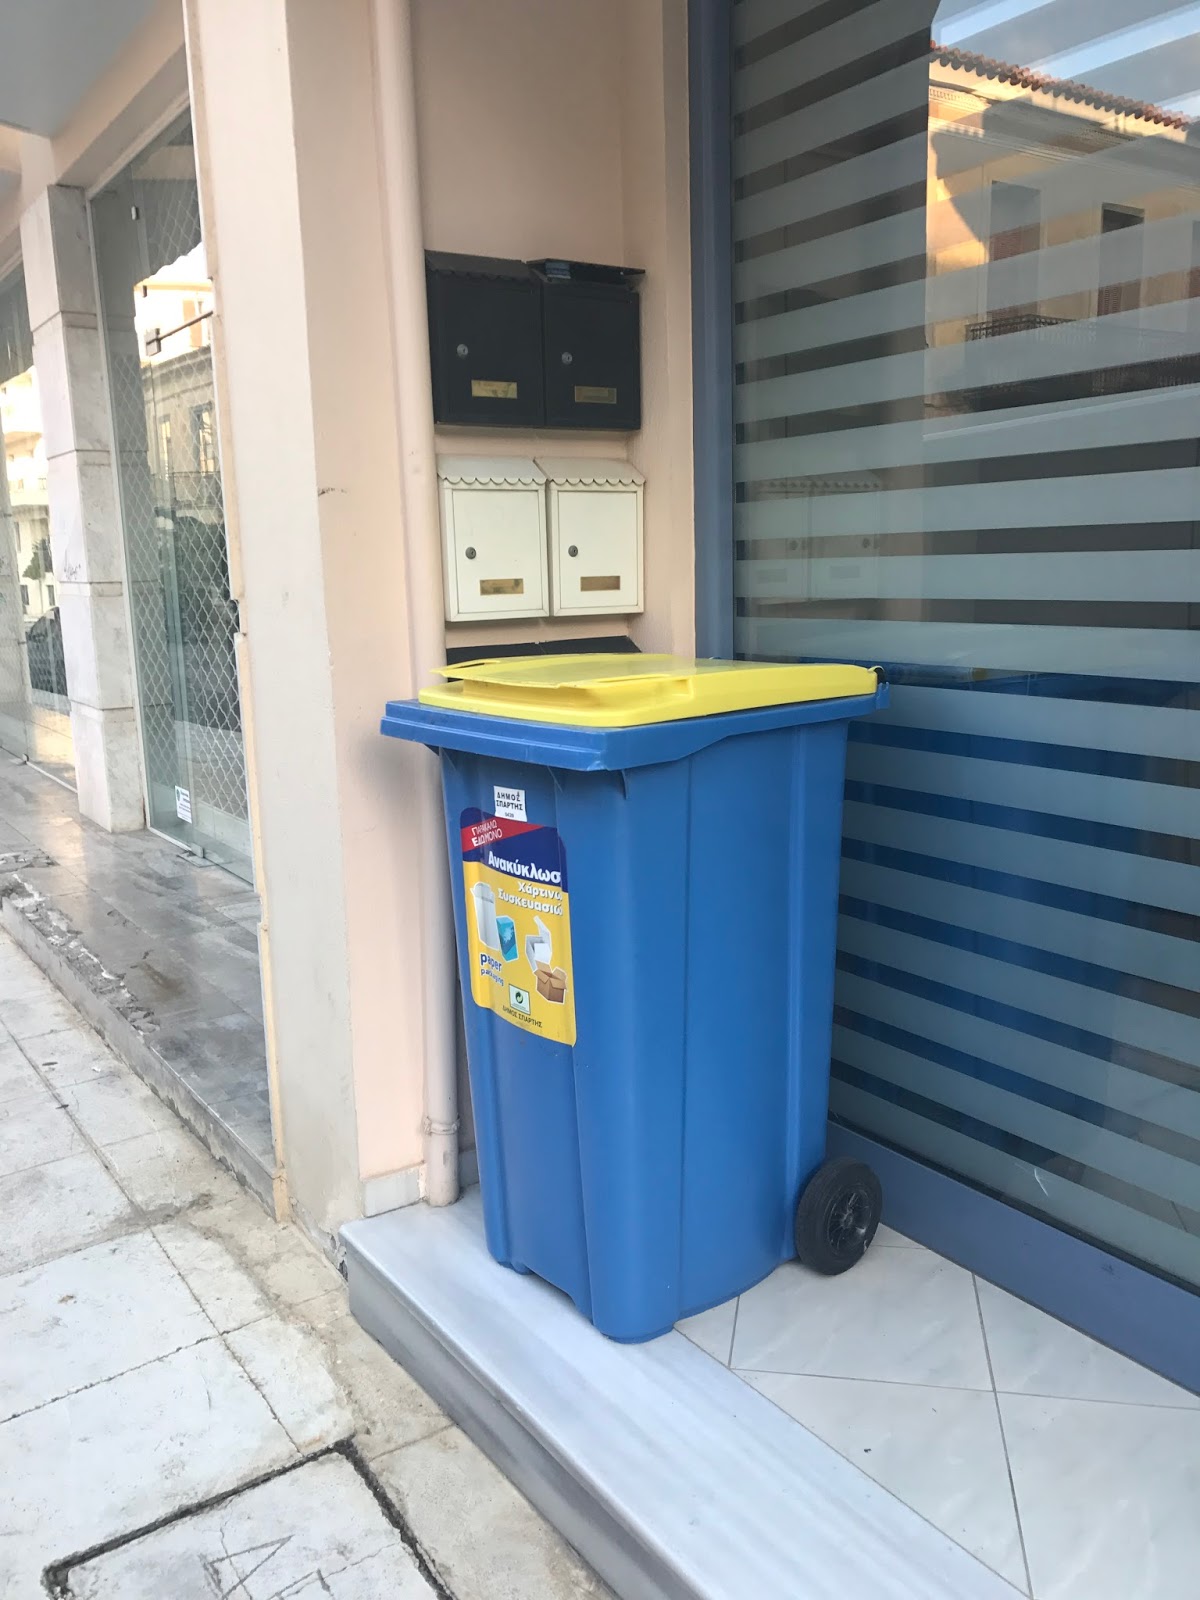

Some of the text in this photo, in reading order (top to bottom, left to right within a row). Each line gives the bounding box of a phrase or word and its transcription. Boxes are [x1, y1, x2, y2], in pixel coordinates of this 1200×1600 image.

[496, 791, 521, 802] ΔΗΜΟΣ
[496, 800, 523, 811] ΣΠΑΡΤΗΣ
[488, 850, 561, 883] Ανακύκλωσ
[518, 881, 562, 901] Χάρτινω
[498, 888, 563, 916] Συσκευασιώ
[480, 953, 502, 971] paper
